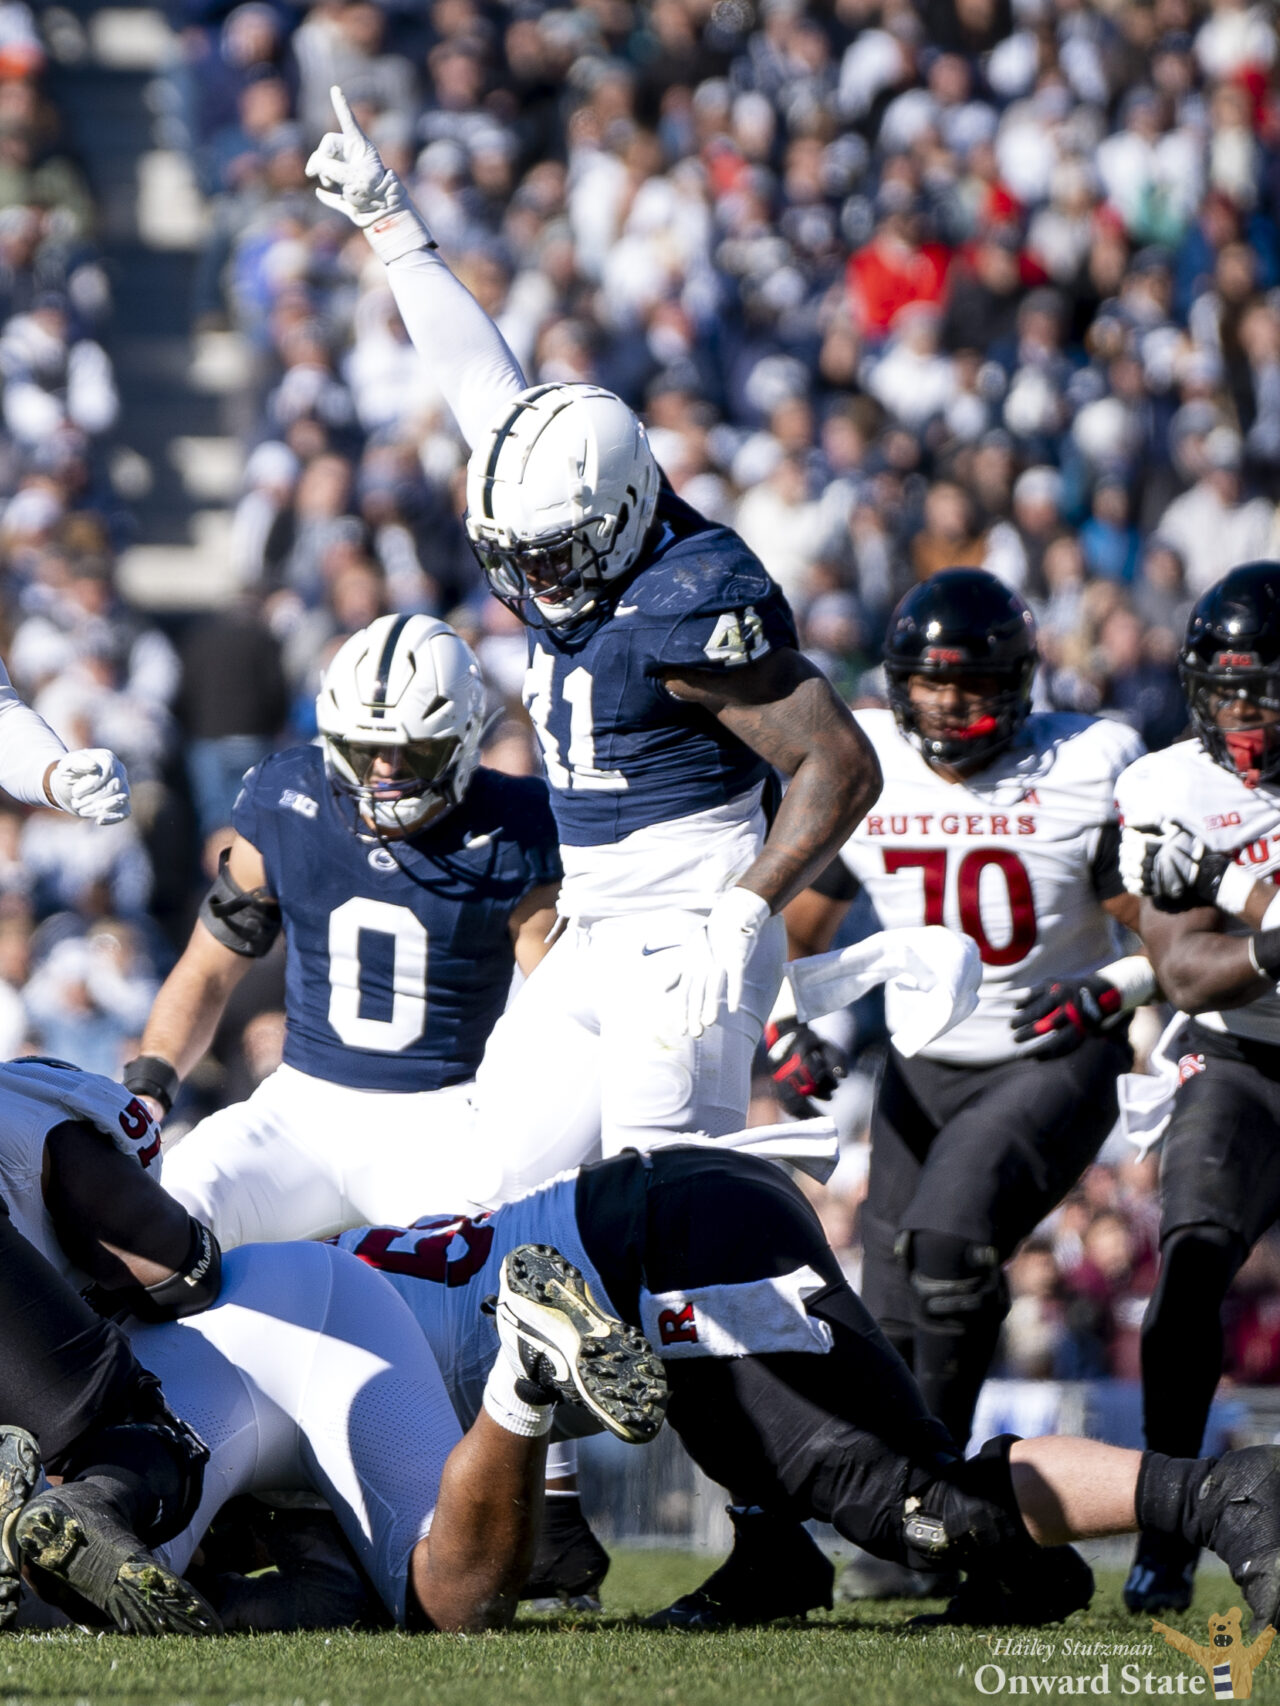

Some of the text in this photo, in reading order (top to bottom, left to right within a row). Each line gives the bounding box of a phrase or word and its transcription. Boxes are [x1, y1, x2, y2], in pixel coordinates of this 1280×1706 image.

[867, 813, 1037, 836] RUTGERS
[882, 847, 1038, 967] 70
[328, 896, 428, 1053] 0
[118, 1097, 162, 1169] 51
[658, 1302, 699, 1346] R
